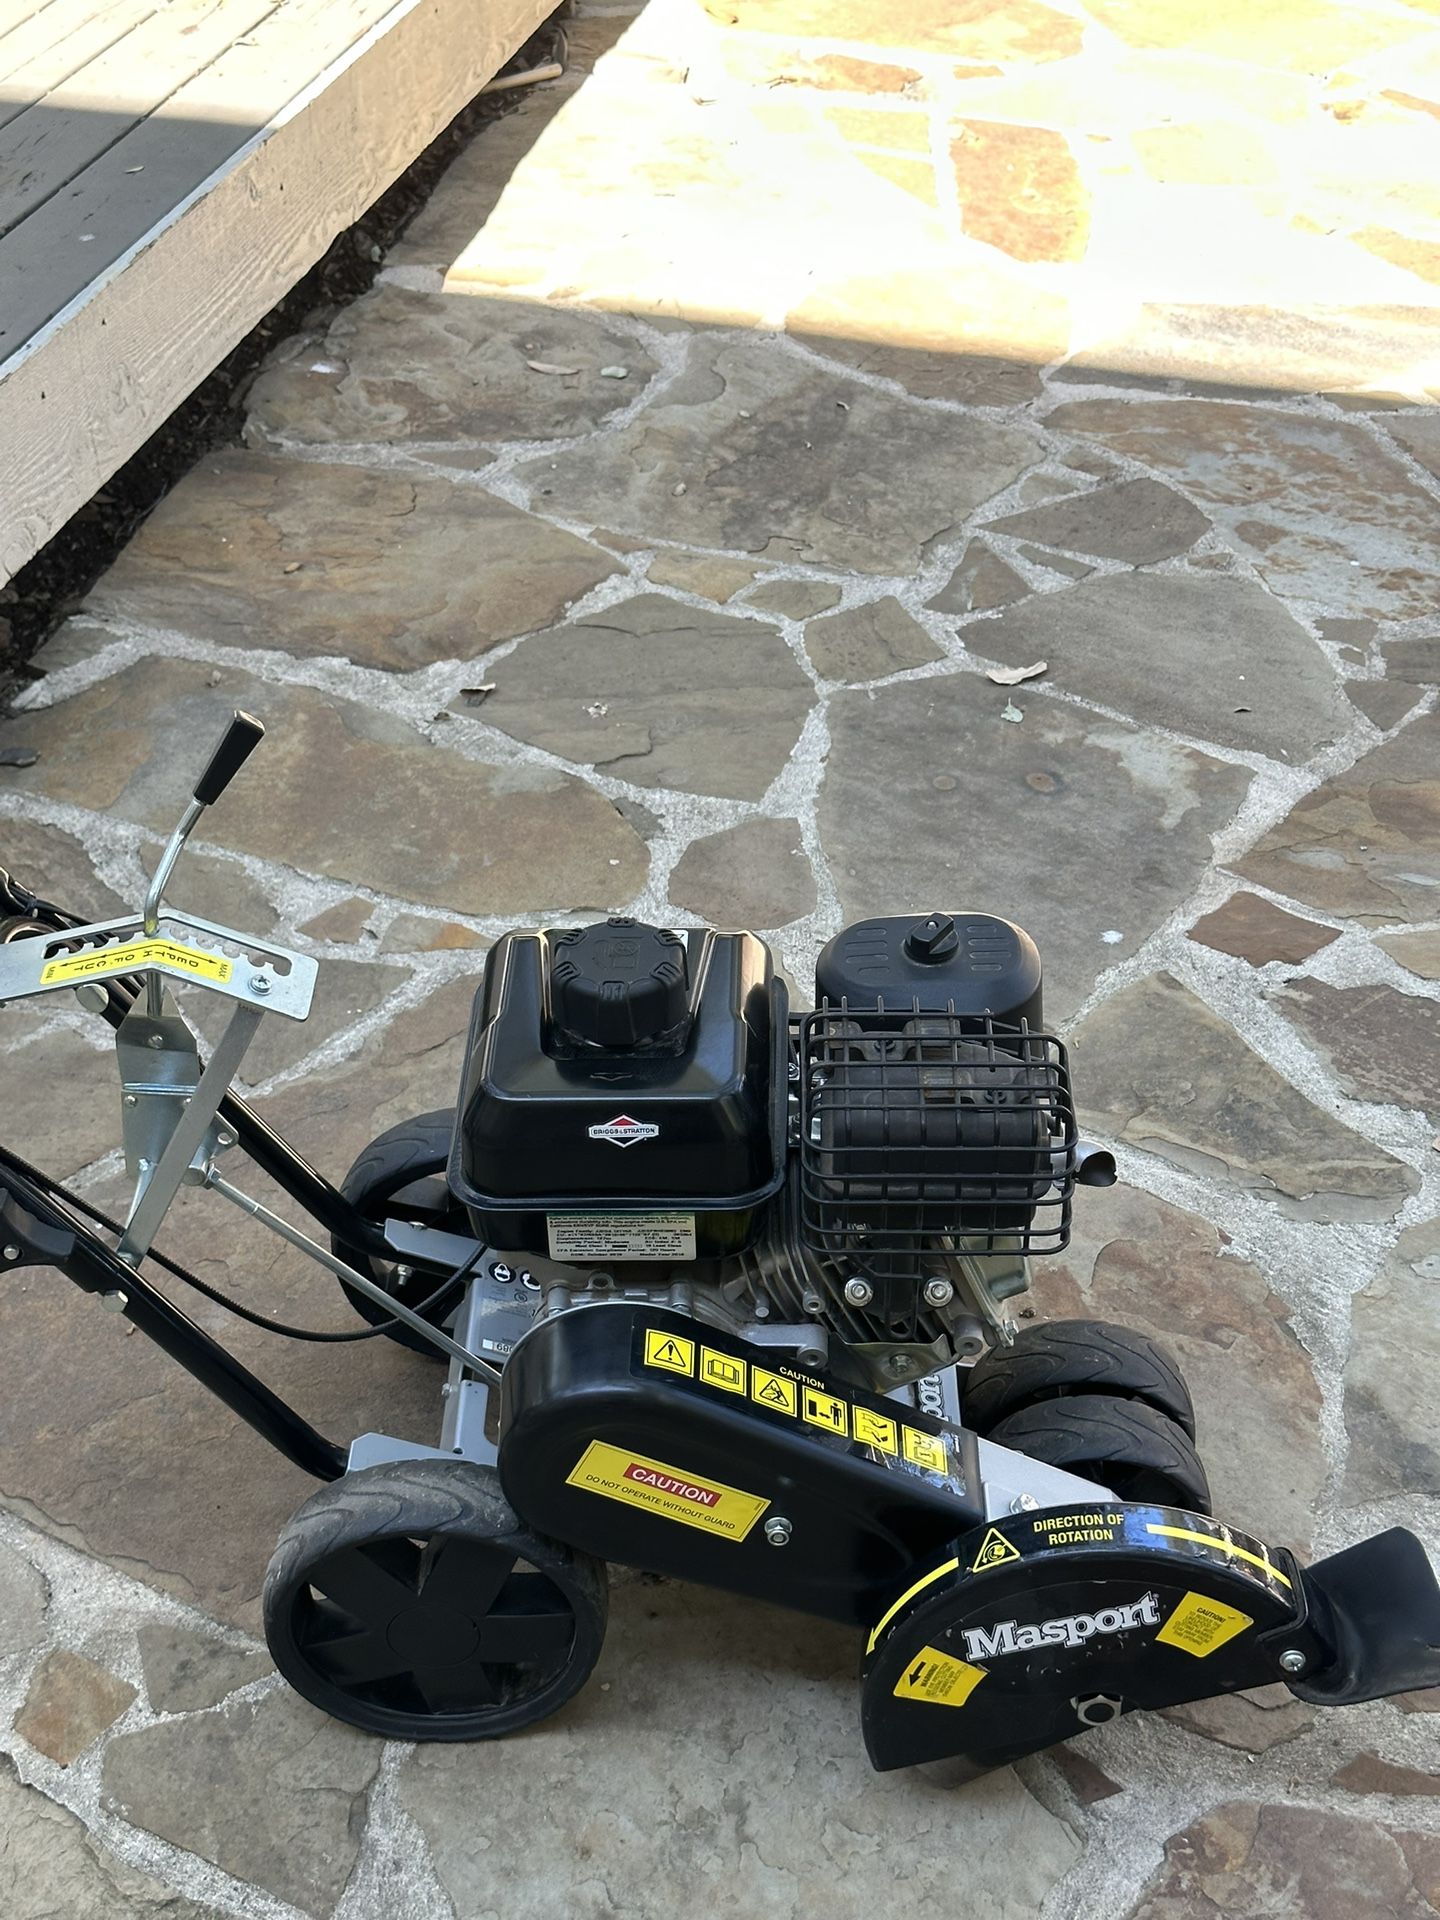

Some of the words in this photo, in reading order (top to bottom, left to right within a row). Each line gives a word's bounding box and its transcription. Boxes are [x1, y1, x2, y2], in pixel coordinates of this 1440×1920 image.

[74, 960, 106, 971] CUT
[114, 954, 135, 963] OF
[143, 950, 199, 967] DEPTH
[779, 1366, 825, 1390] CAUTION
[631, 1468, 714, 1504] CAUTION
[585, 1474, 600, 1483] DO
[600, 1478, 622, 1490] NOT
[621, 1486, 662, 1505] OPERATE
[662, 1500, 704, 1519] WITHOUT
[704, 1514, 736, 1530] GUARD
[1033, 1514, 1104, 1533] DIRECTION
[1106, 1513, 1125, 1525] OF
[1048, 1529, 1114, 1545] ROTATION
[1196, 1607, 1226, 1624] CAUTION!
[962, 1591, 1160, 1661] Masport
